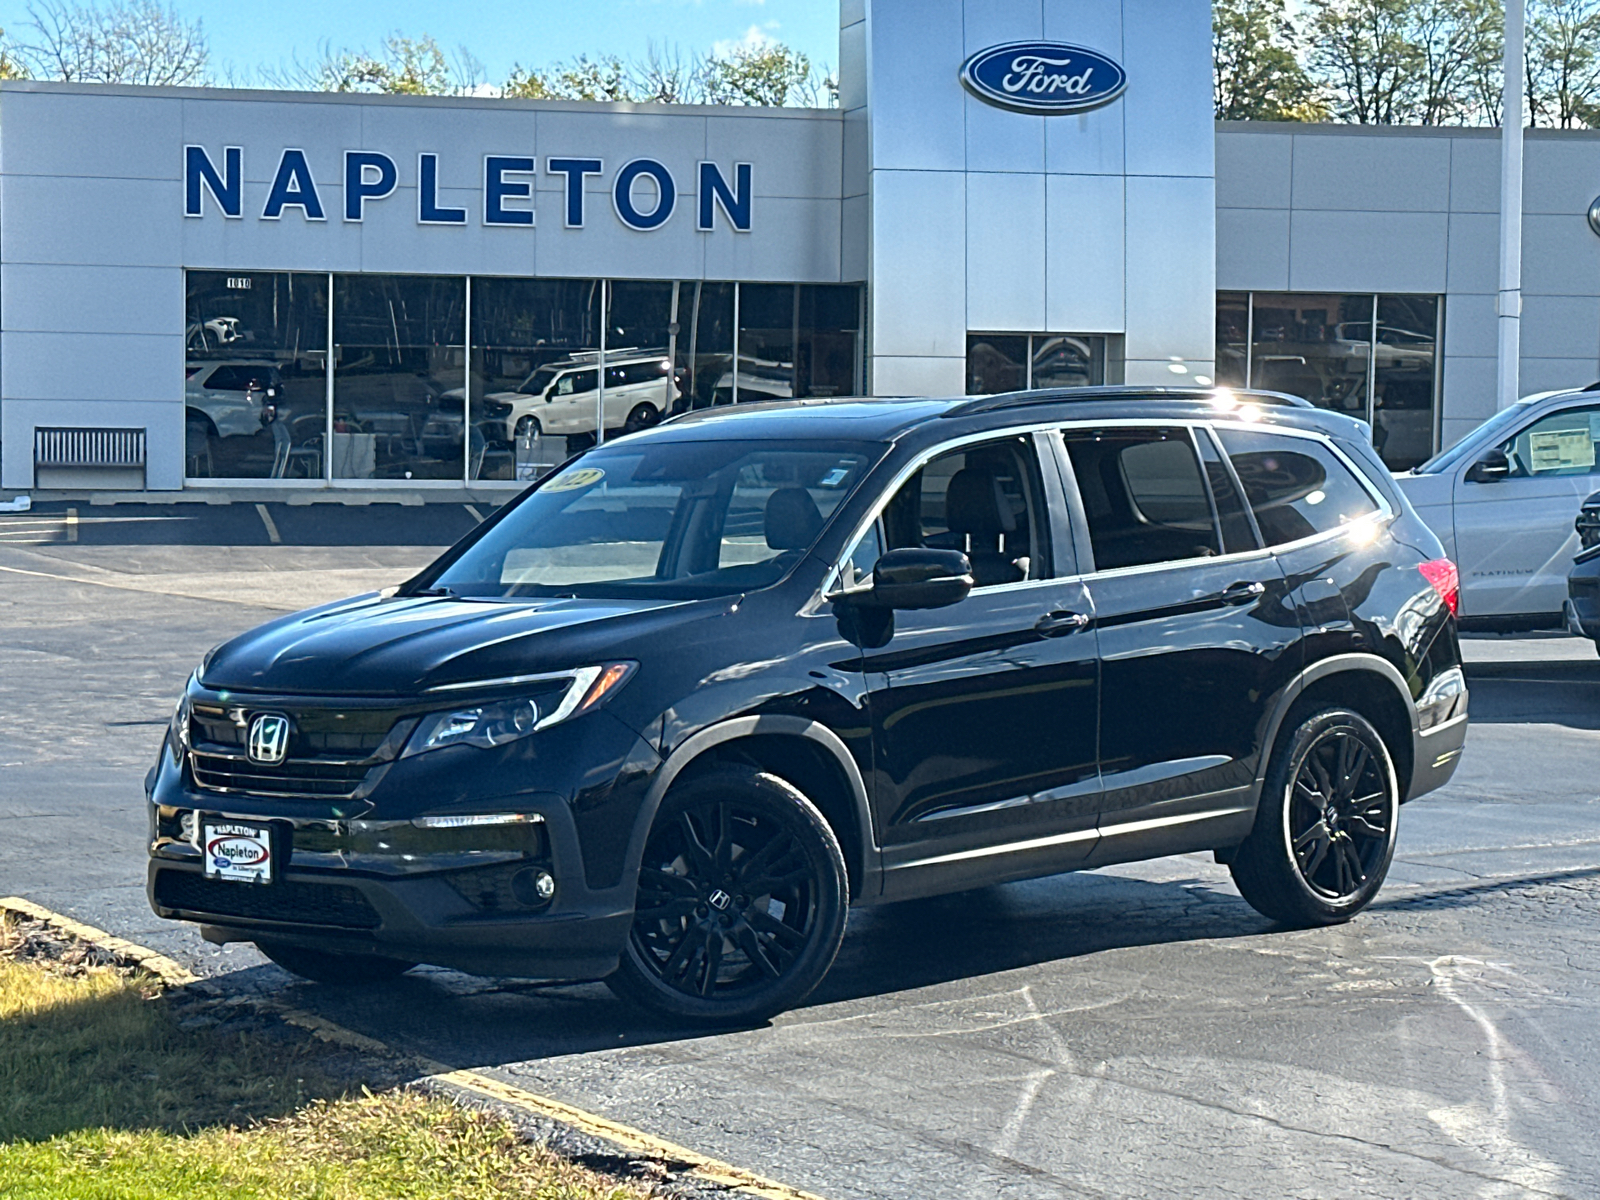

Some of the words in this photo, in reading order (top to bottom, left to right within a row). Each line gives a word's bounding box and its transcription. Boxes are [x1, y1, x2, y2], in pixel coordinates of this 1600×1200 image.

[1002, 55, 1094, 94] Ford
[183, 145, 753, 232] NAPLETON
[1472, 568, 1534, 577] PLATINUM
[218, 843, 259, 859] Napleton
